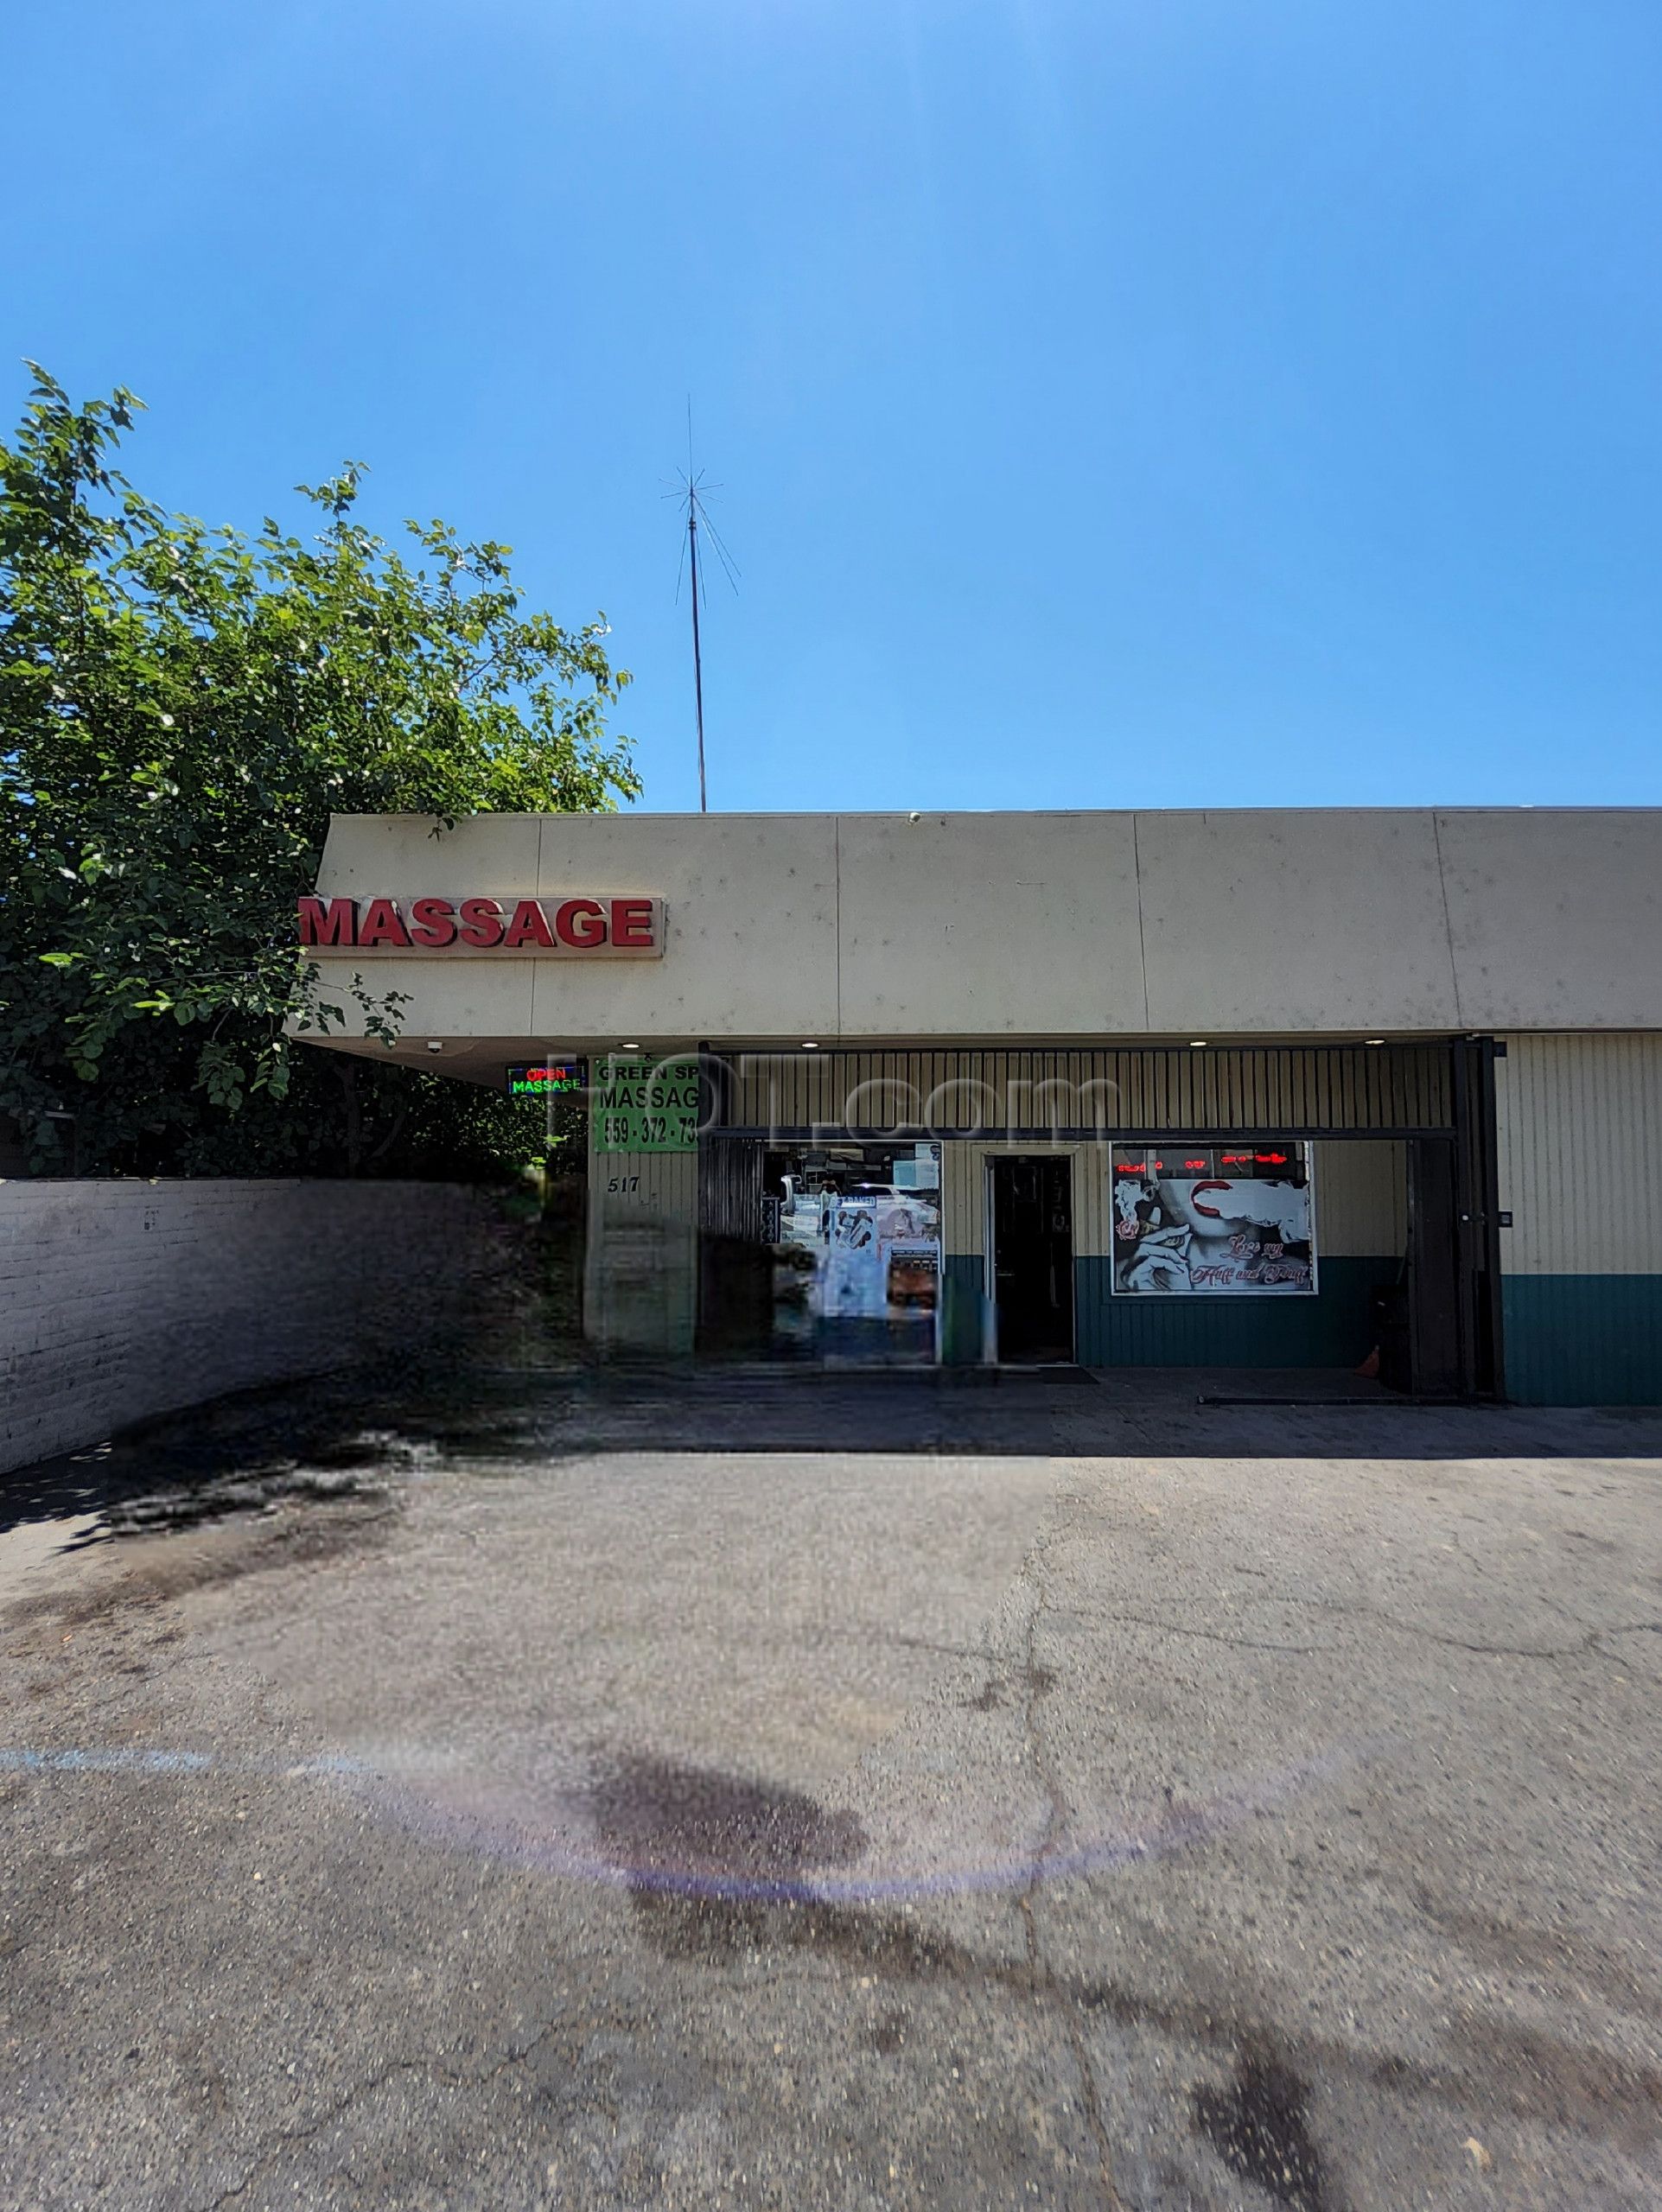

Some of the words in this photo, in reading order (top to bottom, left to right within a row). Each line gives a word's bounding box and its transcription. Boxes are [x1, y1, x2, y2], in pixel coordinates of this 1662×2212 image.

[298, 897, 653, 948] MASSAGE
[526, 1068, 566, 1081] OPEN
[599, 1066, 667, 1080] GREEN
[513, 1078, 581, 1093] MASSAGE
[608, 1176, 640, 1192] 517
